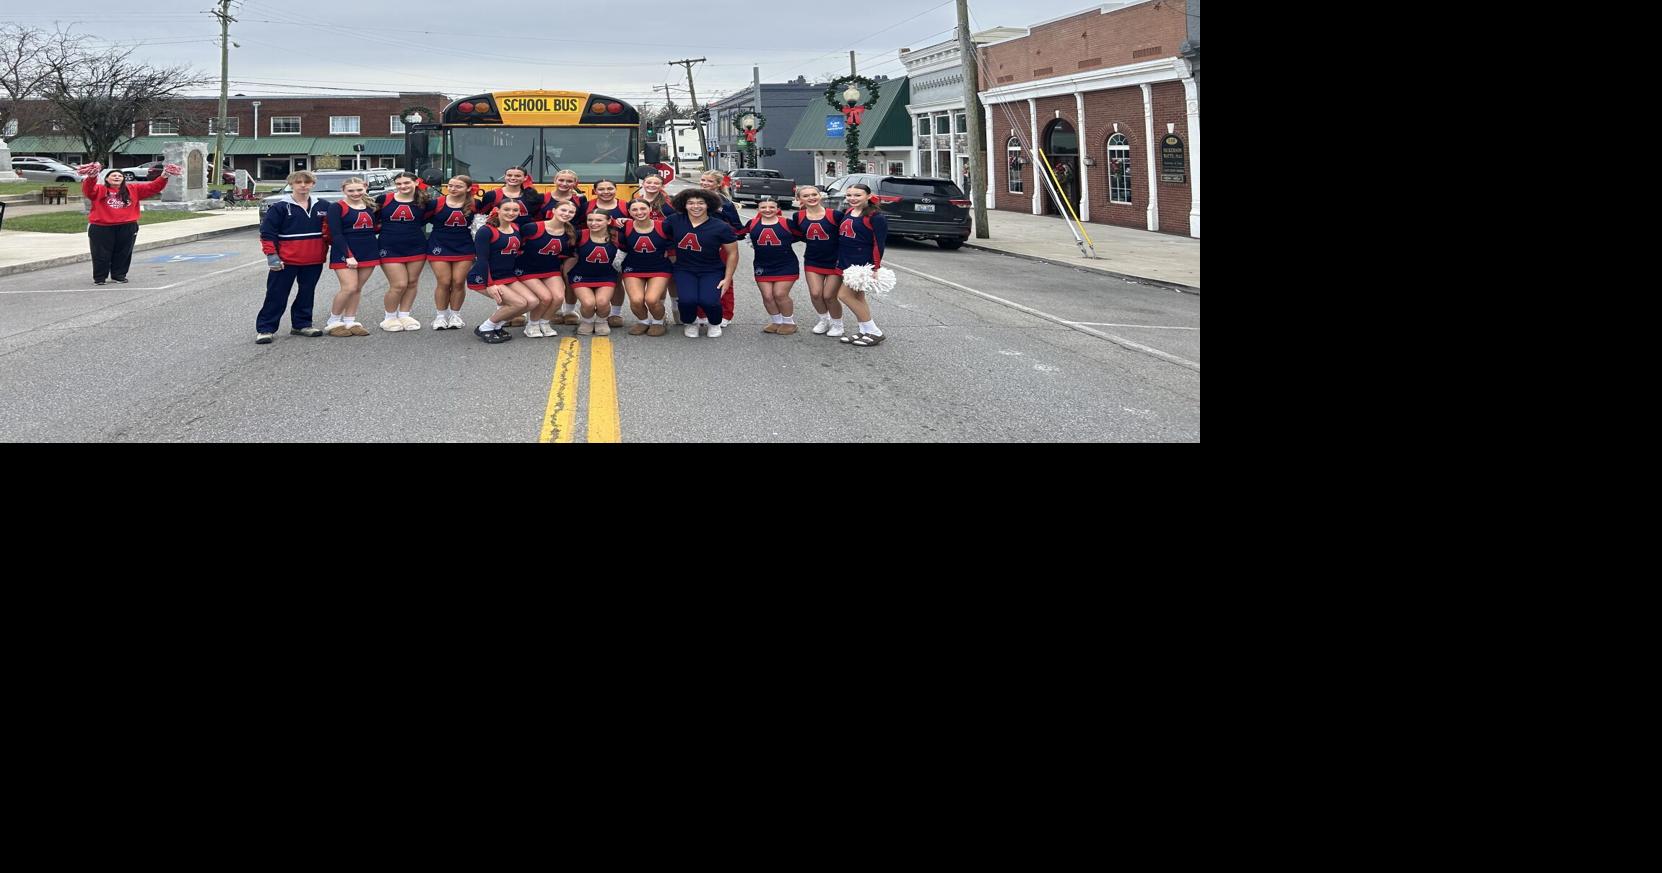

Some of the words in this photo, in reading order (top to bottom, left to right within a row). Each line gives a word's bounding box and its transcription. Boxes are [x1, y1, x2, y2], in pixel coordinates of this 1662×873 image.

[503, 98, 551, 112] SCHOOL
[553, 98, 578, 112] BUS
[658, 169, 671, 179] OP
[353, 211, 374, 230] A
[390, 204, 415, 221] A
[444, 210, 468, 227] A
[757, 227, 782, 246] A
[806, 222, 830, 241] A
[840, 218, 857, 239] A
[501, 236, 522, 255] A
[538, 238, 563, 256] A
[633, 236, 657, 253] A
[678, 232, 703, 252] A
[586, 246, 610, 264] A
